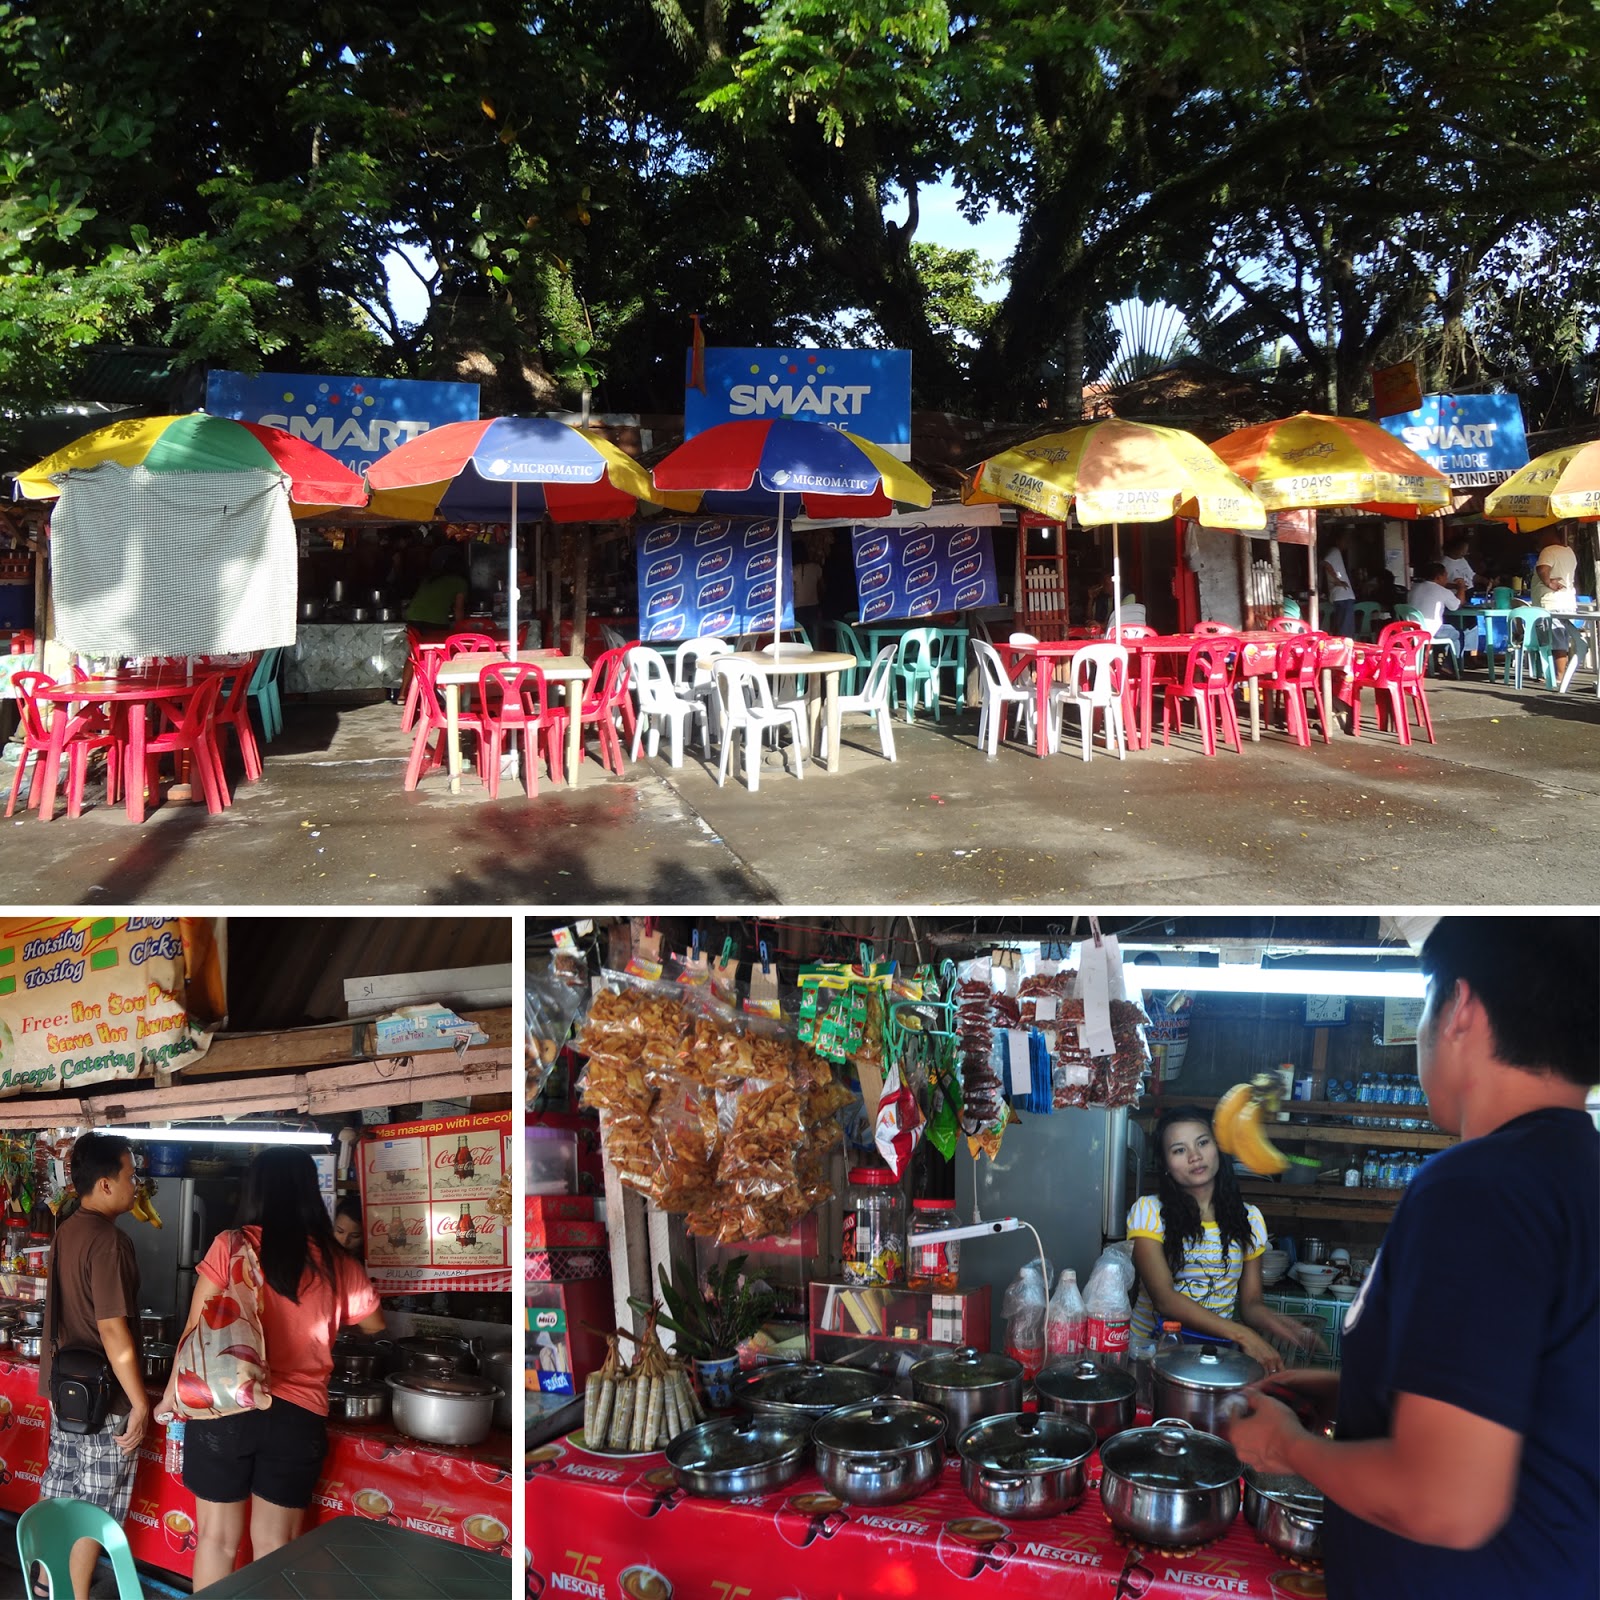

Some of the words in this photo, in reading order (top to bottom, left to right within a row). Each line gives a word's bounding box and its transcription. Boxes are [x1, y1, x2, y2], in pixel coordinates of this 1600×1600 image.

[729, 385, 872, 415] SMART
[1401, 423, 1497, 450] SMART
[512, 463, 593, 477] MICROMATIC
[1452, 453, 1488, 469] MORE
[792, 474, 869, 490] MICROMATIC
[1012, 473, 1020, 485] 2
[1020, 475, 1044, 493] DAYS
[1292, 479, 1298, 490] 2
[1301, 476, 1332, 488] DAYS
[1404, 475, 1425, 487] DAYS
[1118, 492, 1125, 504] 2
[1128, 491, 1159, 504] DAYS
[23, 929, 84, 961] Hotsilog
[24, 959, 85, 989] Tosilog
[21, 1014, 68, 1034] Free:
[414, 1016, 428, 1029] 15
[0, 1063, 56, 1091] Accept
[60, 1050, 135, 1079] Catering
[398, 1123, 443, 1135] masarap
[446, 1117, 471, 1129] with
[386, 1269, 424, 1279] BULALO
[538, 1316, 556, 1324] MILO
[25, 1404, 45, 1419] 75
[138, 1500, 160, 1518] 75
[421, 1502, 456, 1525] 75
[565, 1549, 602, 1583] 75
